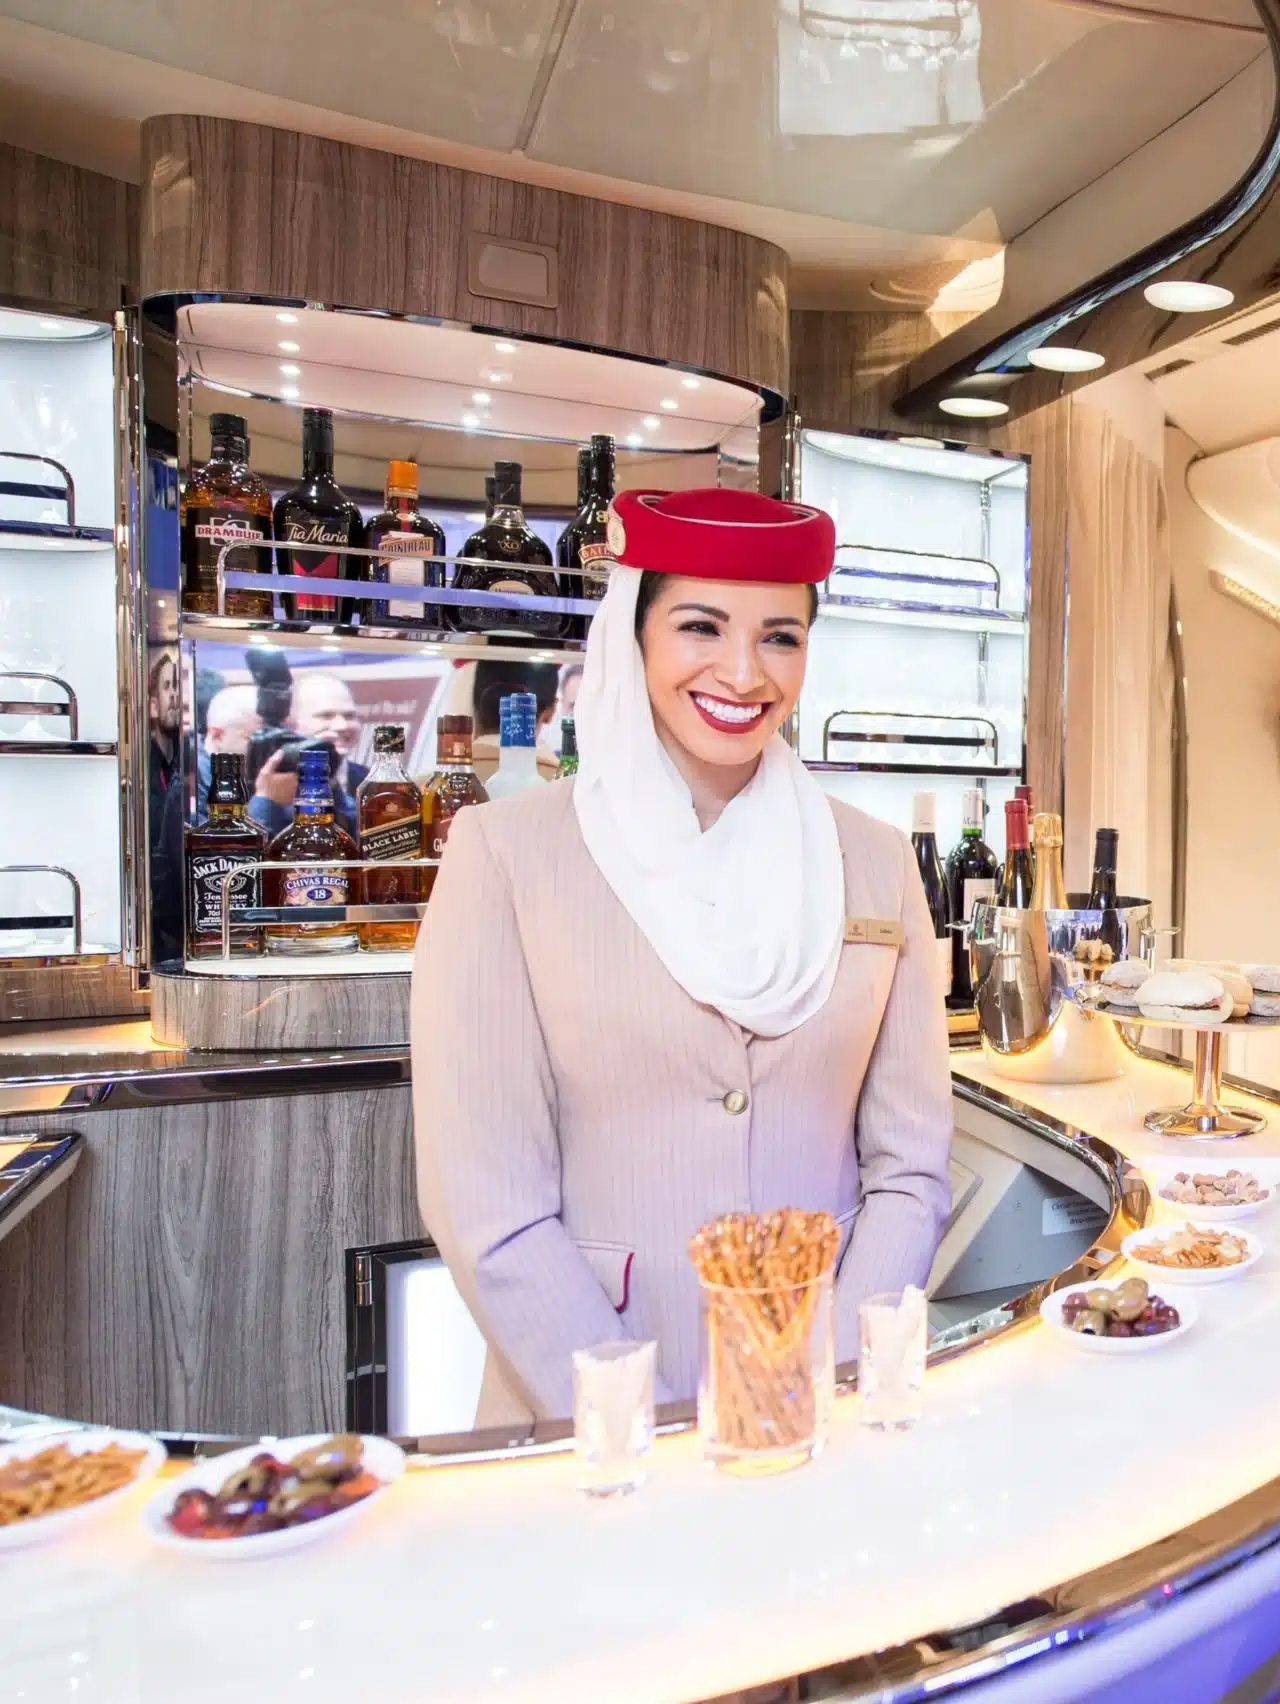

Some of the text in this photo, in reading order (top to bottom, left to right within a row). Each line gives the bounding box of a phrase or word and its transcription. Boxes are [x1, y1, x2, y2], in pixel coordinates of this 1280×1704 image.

[197, 526, 262, 541] DRAMBUIE
[283, 522, 348, 543] Tia Maria
[502, 539, 520, 550] XO
[362, 838, 391, 852] BLACK
[392, 829, 420, 842] LABEL
[193, 862, 219, 879] JACK
[286, 877, 349, 890] CHIVAS REGAL
[203, 892, 248, 901] Tenssee
[314, 889, 327, 899] 18
